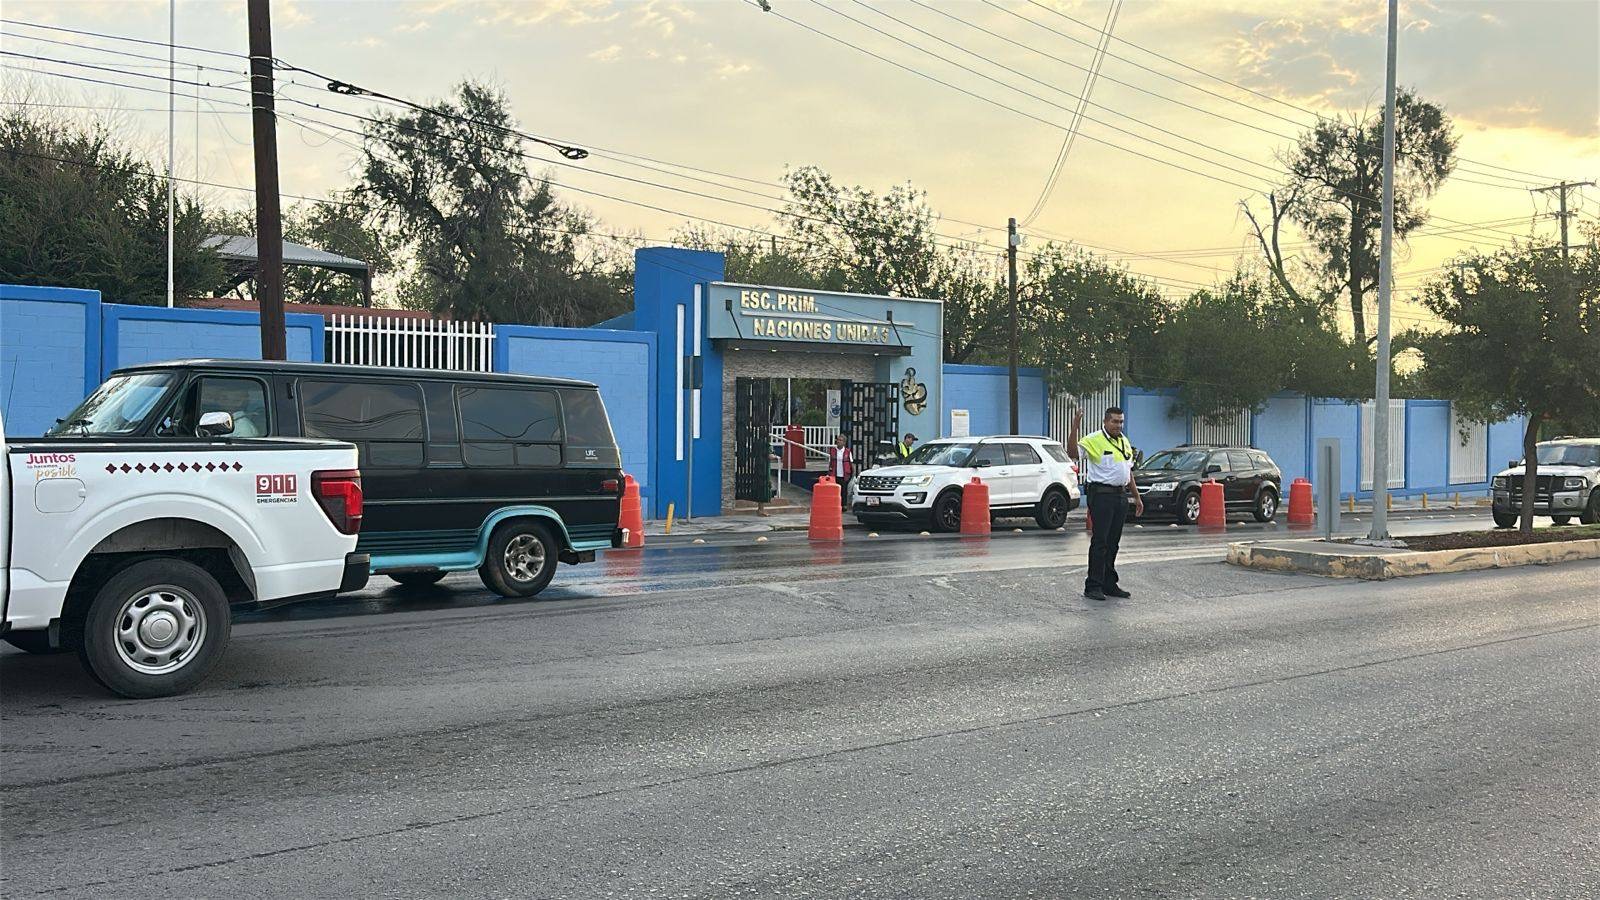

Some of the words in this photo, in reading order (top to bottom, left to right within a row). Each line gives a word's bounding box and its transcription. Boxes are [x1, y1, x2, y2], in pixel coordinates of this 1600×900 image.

[753, 318, 832, 340] NACIONES
[836, 323, 889, 343] UNIDAS
[26, 453, 76, 464] Juntos
[35, 464, 77, 481] posible
[259, 476, 295, 491] 911
